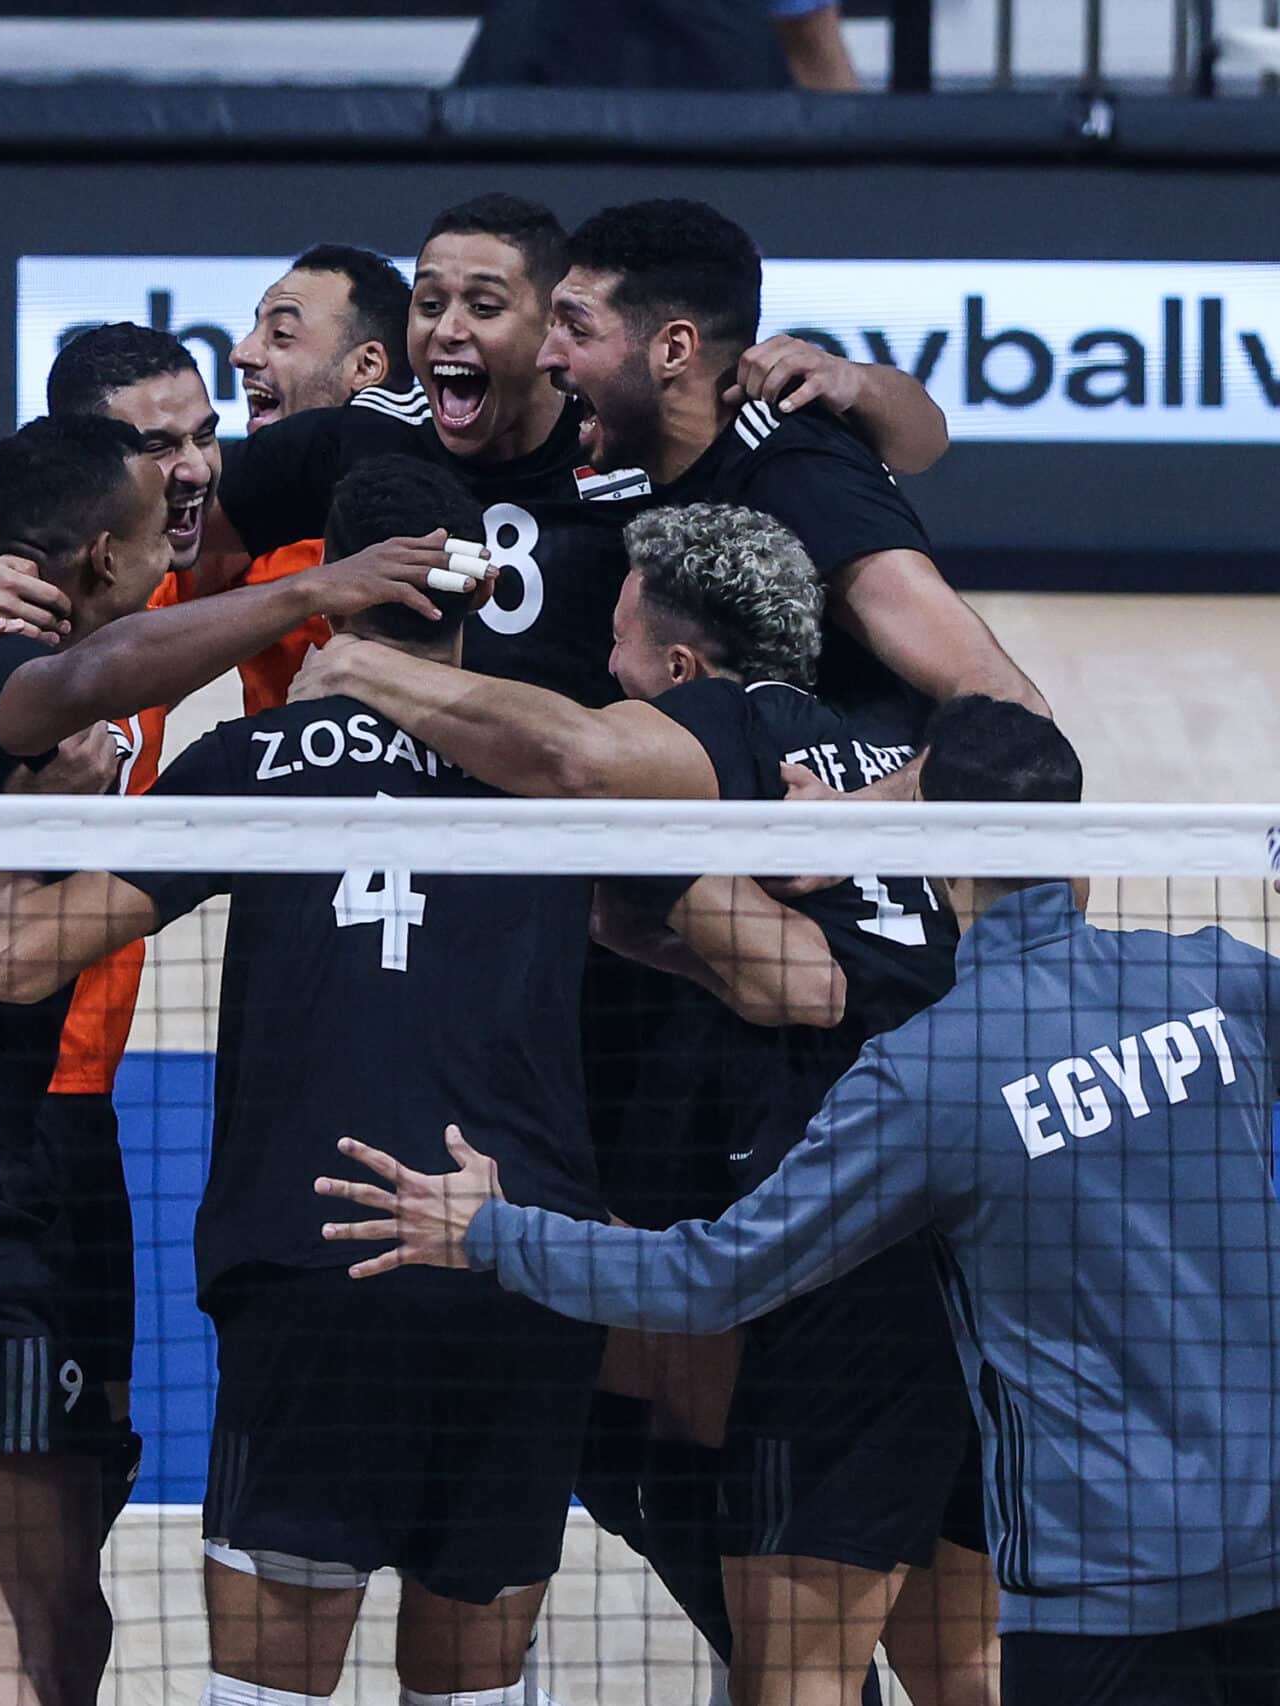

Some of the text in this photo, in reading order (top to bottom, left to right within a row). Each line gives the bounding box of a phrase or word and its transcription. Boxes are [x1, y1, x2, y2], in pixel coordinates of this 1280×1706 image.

[478, 502, 544, 635] 8
[1000, 1006, 1237, 1160] EGYPT
[58, 1359, 84, 1414] 9
